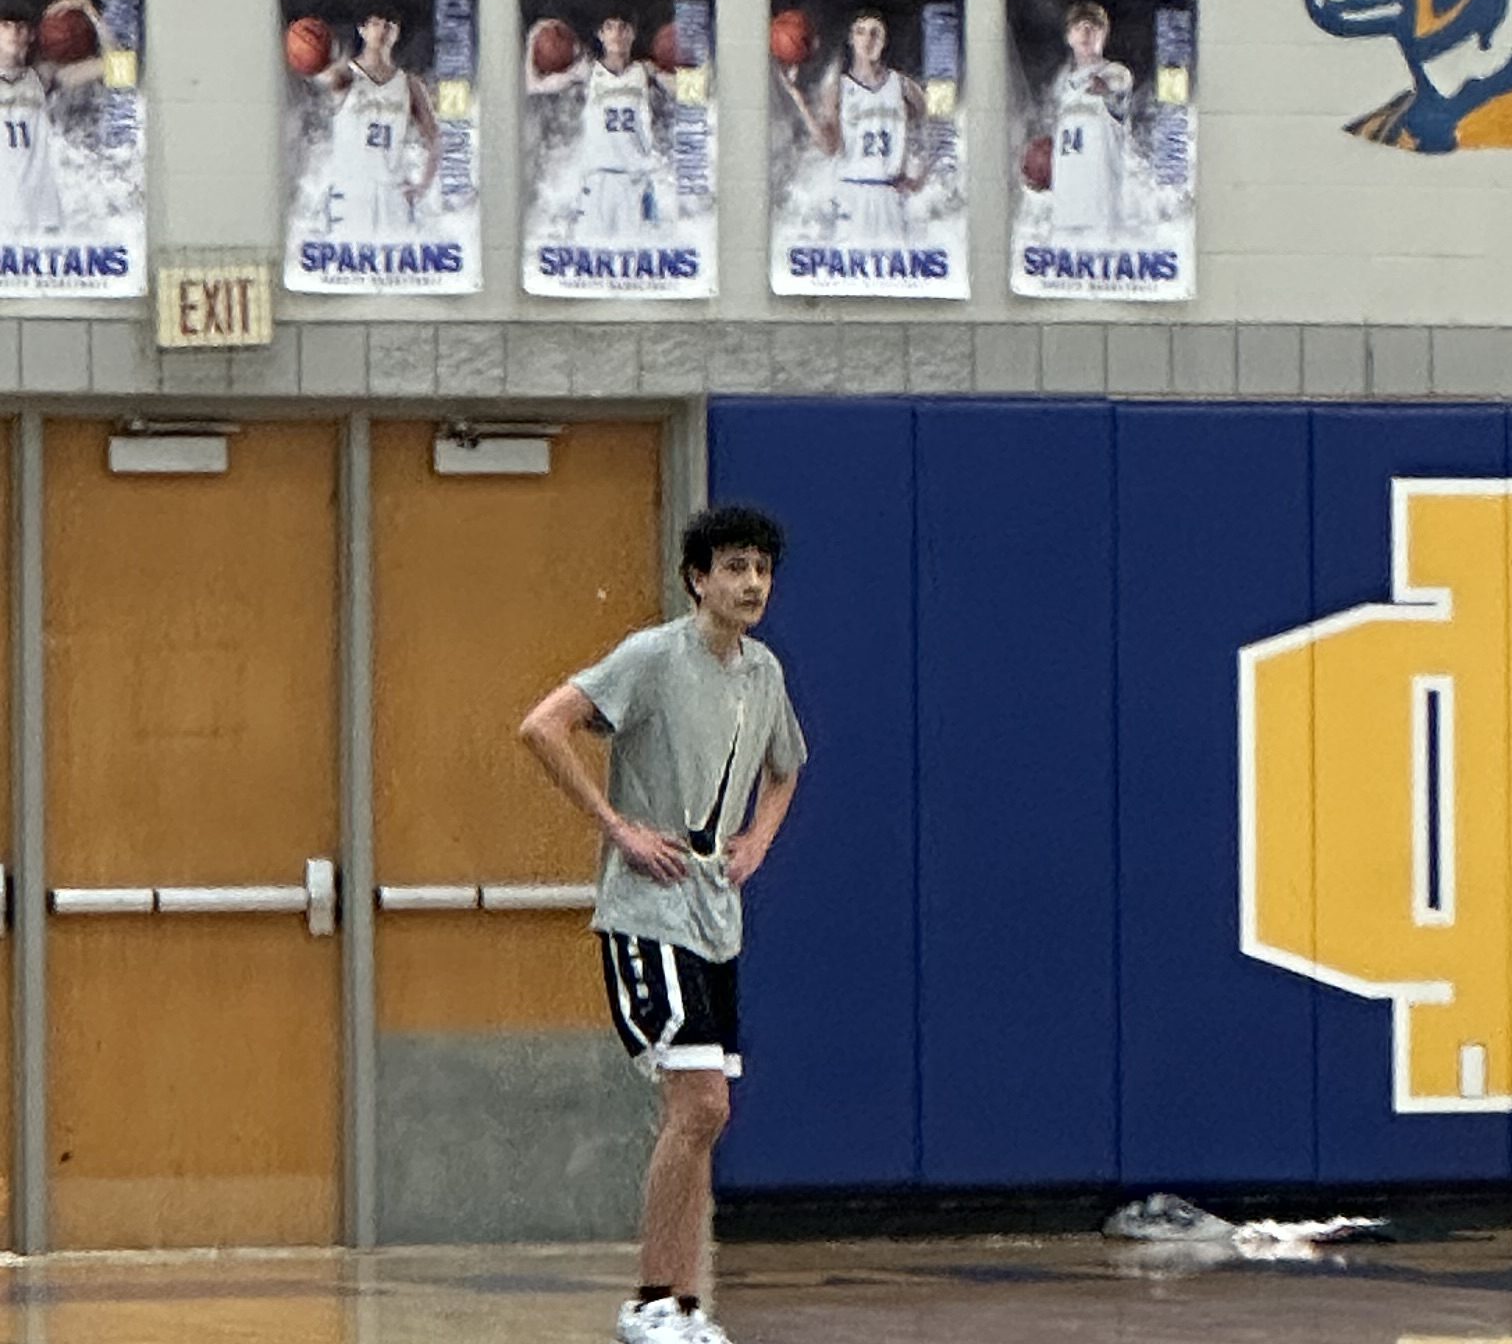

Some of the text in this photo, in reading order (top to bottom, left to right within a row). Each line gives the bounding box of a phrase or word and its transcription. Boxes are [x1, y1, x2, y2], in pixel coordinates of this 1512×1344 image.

[5, 120, 31, 149] 11
[366, 121, 393, 149] 21
[605, 107, 636, 133] 22
[301, 241, 464, 274] SPARTANS
[539, 246, 700, 279] SPARTANS
[788, 247, 949, 278] SPARTANS
[1023, 246, 1178, 280] SPARTANS
[178, 277, 254, 337] EXIT
